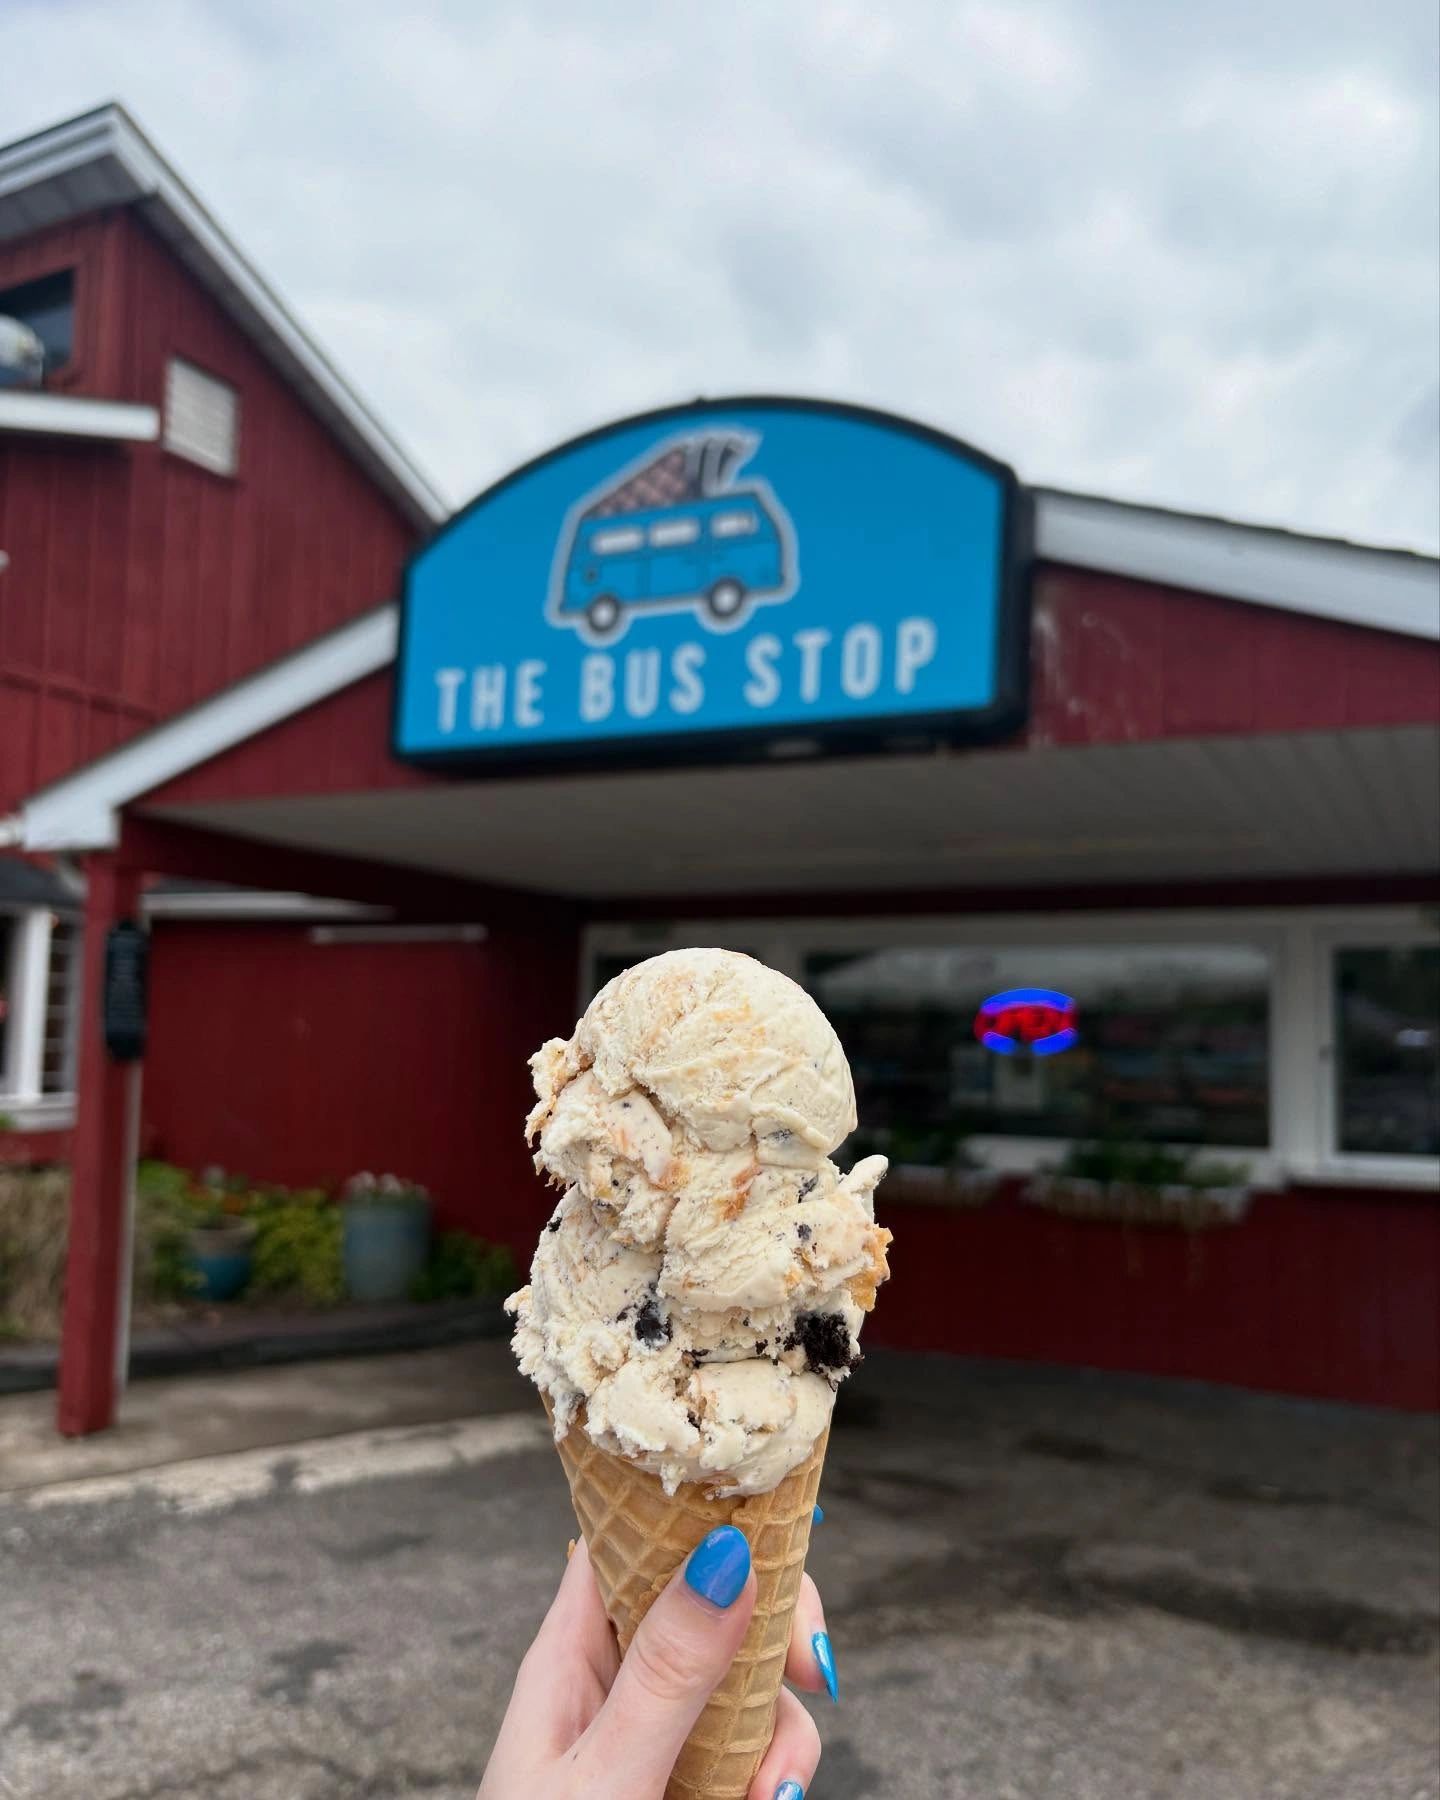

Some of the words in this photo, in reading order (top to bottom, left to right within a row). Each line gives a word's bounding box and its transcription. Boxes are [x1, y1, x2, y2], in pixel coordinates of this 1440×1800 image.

[434, 659, 547, 734] THE
[579, 641, 706, 723] BUS
[743, 616, 938, 708] STOP
